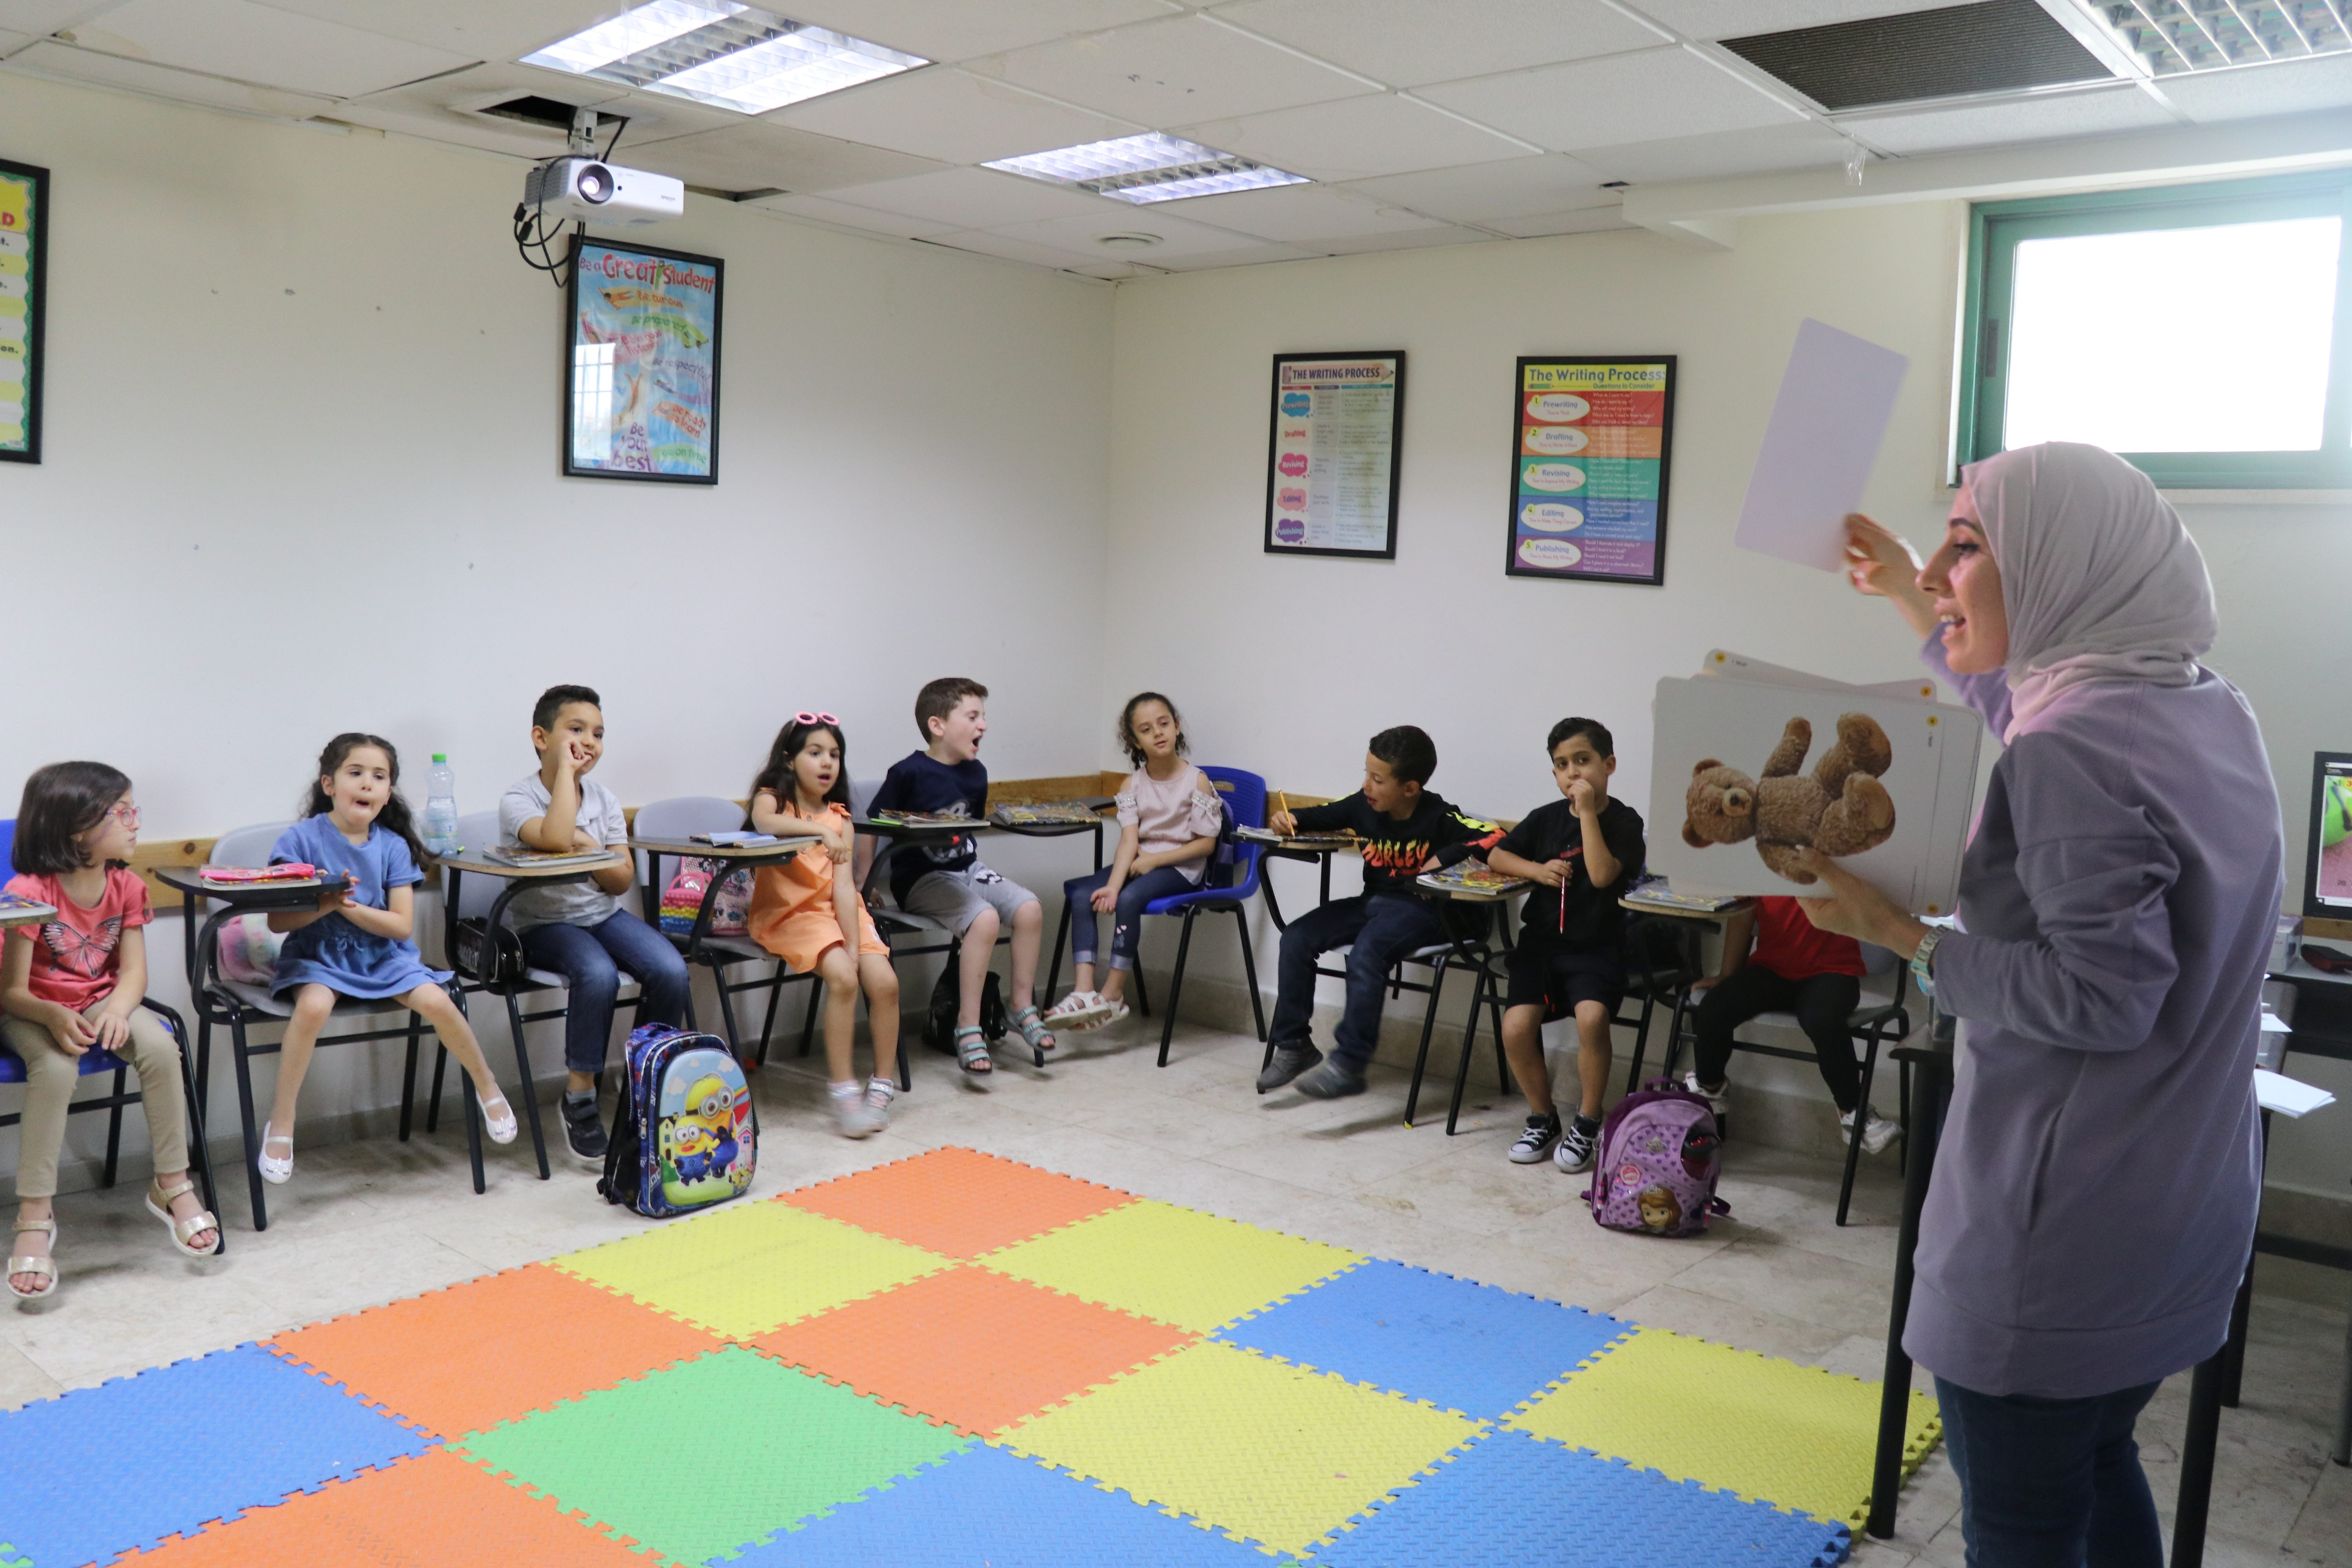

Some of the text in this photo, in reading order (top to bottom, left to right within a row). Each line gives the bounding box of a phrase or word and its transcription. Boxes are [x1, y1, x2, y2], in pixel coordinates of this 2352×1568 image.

[579, 256, 592, 271] Be
[594, 262, 601, 271] a
[603, 254, 657, 285] Great
[637, 290, 683, 308] Be curious
[632, 316, 687, 330] Be prepared
[1293, 367, 1380, 380] THE WRITING PROCESS
[1529, 369, 1553, 381] The
[1556, 368, 1605, 383] Writing
[685, 410, 707, 431] ready
[630, 422, 644, 436] Be
[681, 419, 701, 438] learn
[1285, 430, 1307, 438] Drafting
[1546, 433, 1573, 441] Drafting
[611, 449, 652, 472] best
[676, 448, 687, 456] on
[688, 448, 706, 464] time
[1282, 460, 1305, 468] Revising
[1543, 469, 1570, 477] Revising
[1542, 509, 1564, 518] Editing
[1535, 544, 1570, 554] Publishing
